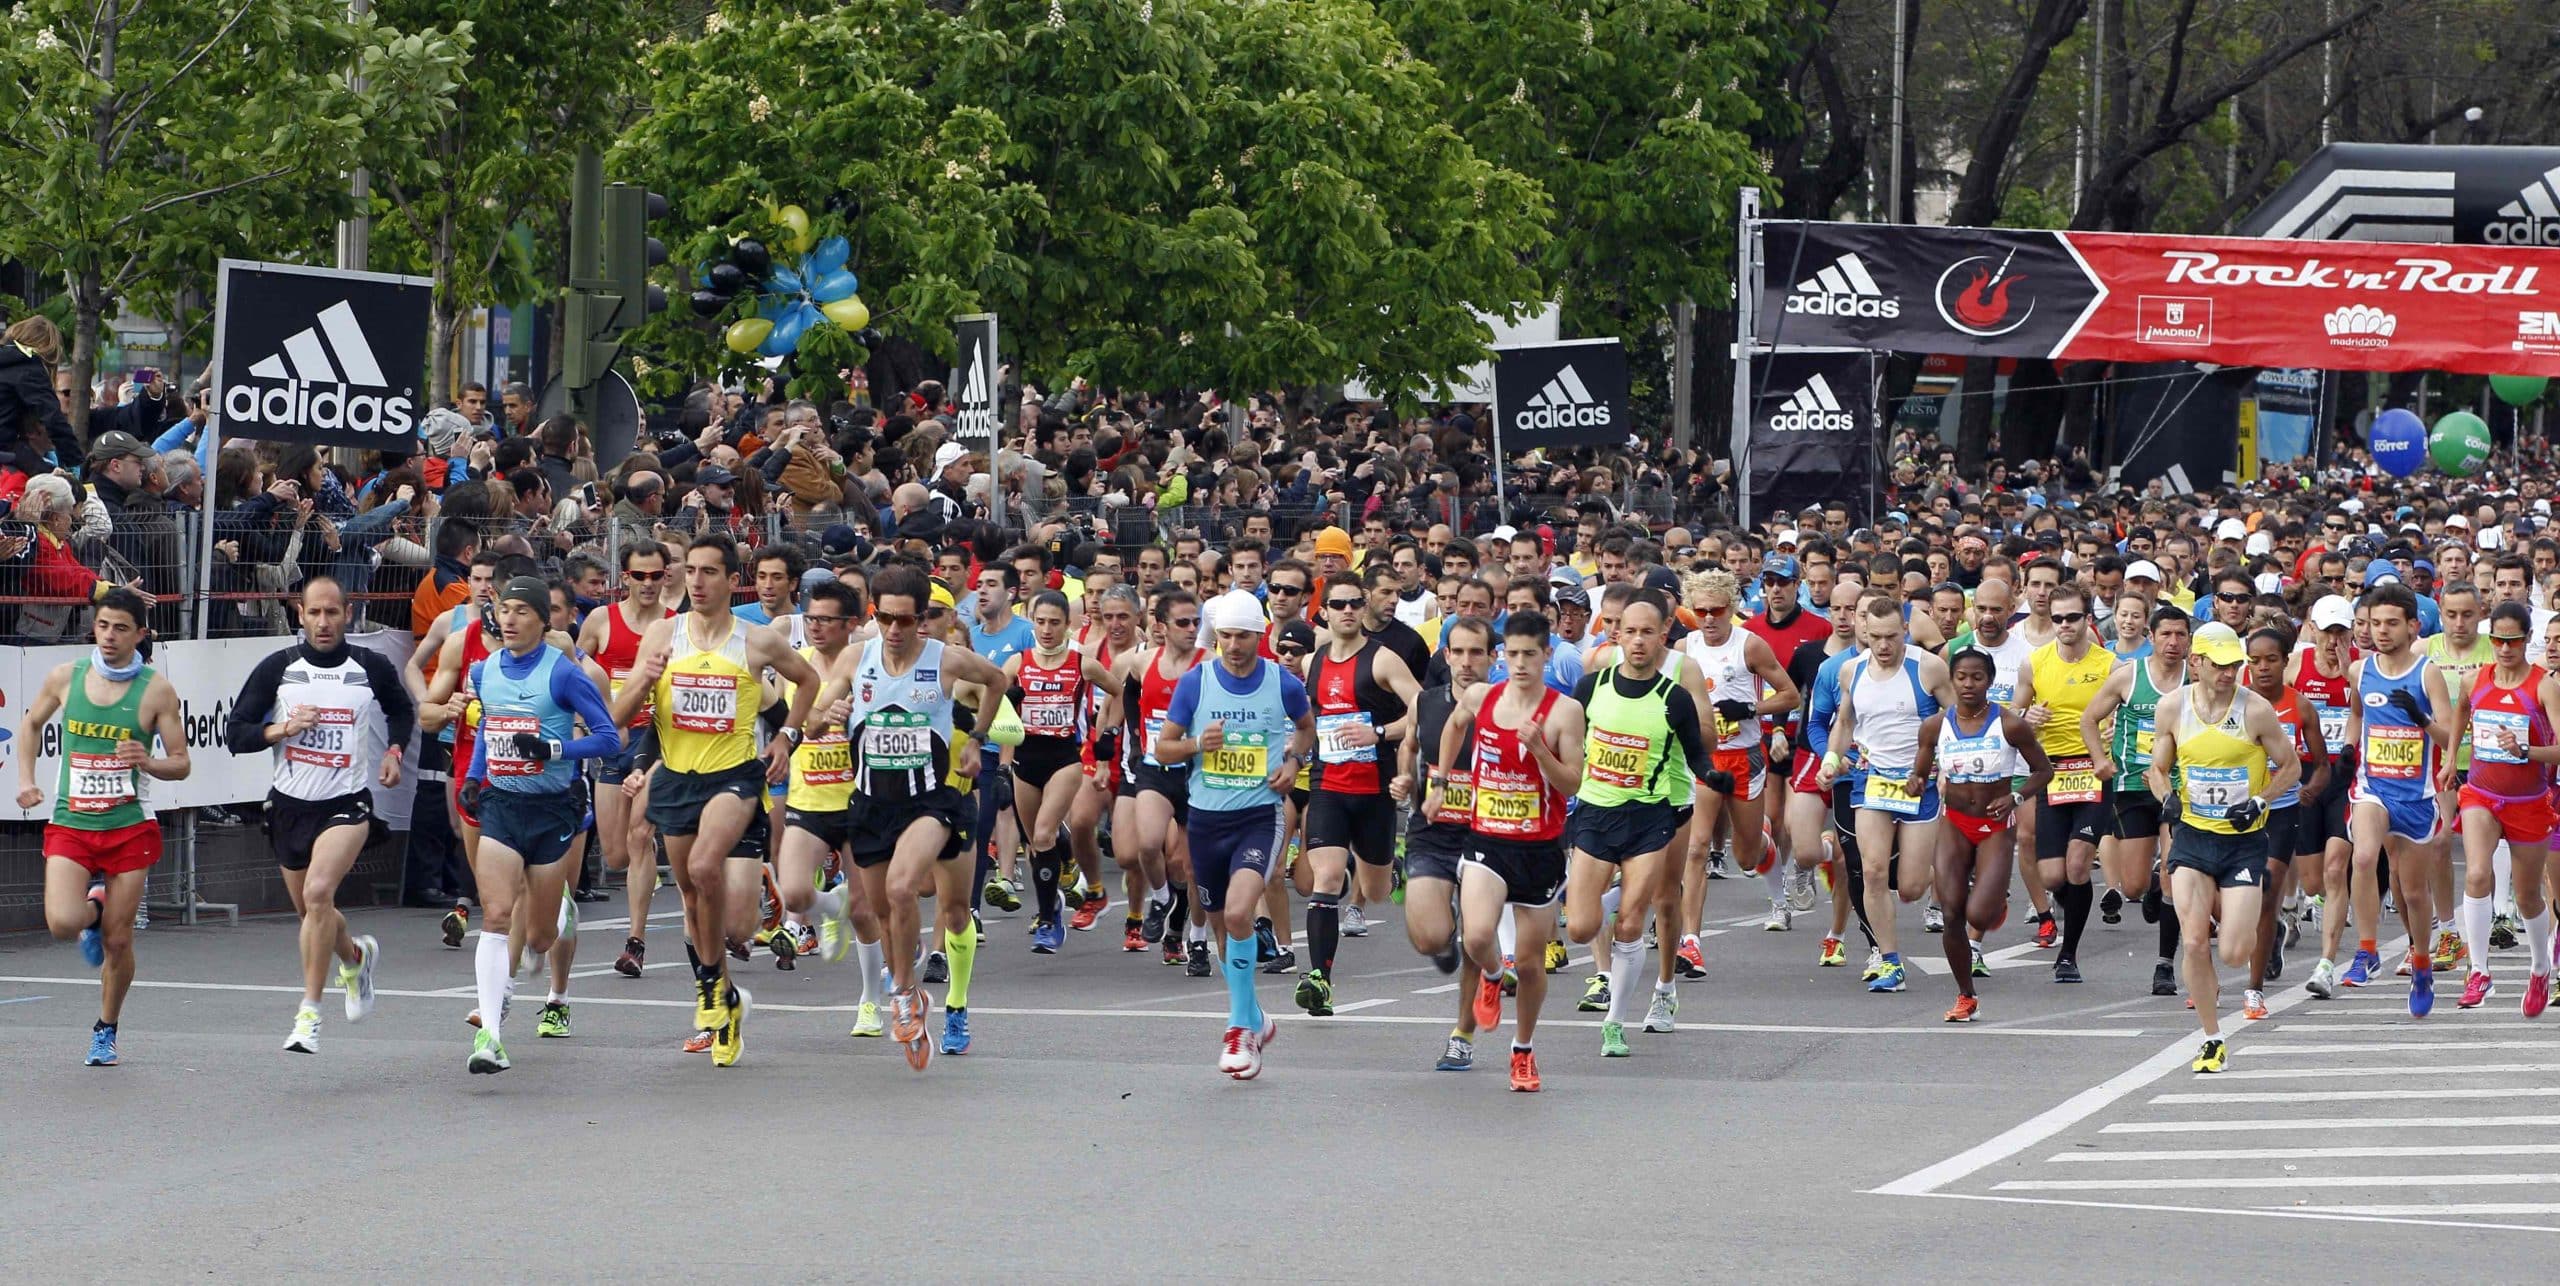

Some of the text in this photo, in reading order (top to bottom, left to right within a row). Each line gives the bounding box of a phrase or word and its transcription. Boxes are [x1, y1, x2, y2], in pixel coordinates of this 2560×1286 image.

[2161, 250, 2340, 287] Rock
[2395, 258, 2541, 295] Roll
[1785, 291, 1900, 319] adidas
[2145, 323, 2204, 340] ¡MADRID!
[2329, 337, 2390, 347] madrid2020
[225, 379, 413, 436] adidas
[1515, 402, 1611, 431] adidas
[957, 402, 991, 438] adidas
[1769, 408, 1855, 432] adidas
[697, 676, 735, 687] adidas
[682, 691, 727, 714] 20010
[1043, 694, 1073, 703] adidas
[502, 719, 537, 730] adidas
[1211, 707, 1258, 723] nerja
[299, 728, 344, 751] 23913
[2324, 723, 2343, 740] 27
[2387, 728, 2421, 739] adidas
[874, 733, 918, 754] 15001
[1611, 736, 1647, 748] adidas
[808, 750, 849, 770] 20022
[891, 756, 930, 767] adidas
[1212, 750, 1256, 773] 15049
[1597, 748, 1638, 772] 20042
[2375, 743, 2414, 763] 20046
[1972, 757, 1985, 774] 9
[80, 775, 124, 795] 23913
[2057, 775, 2094, 792] 20062
[2206, 787, 2229, 806] 12
